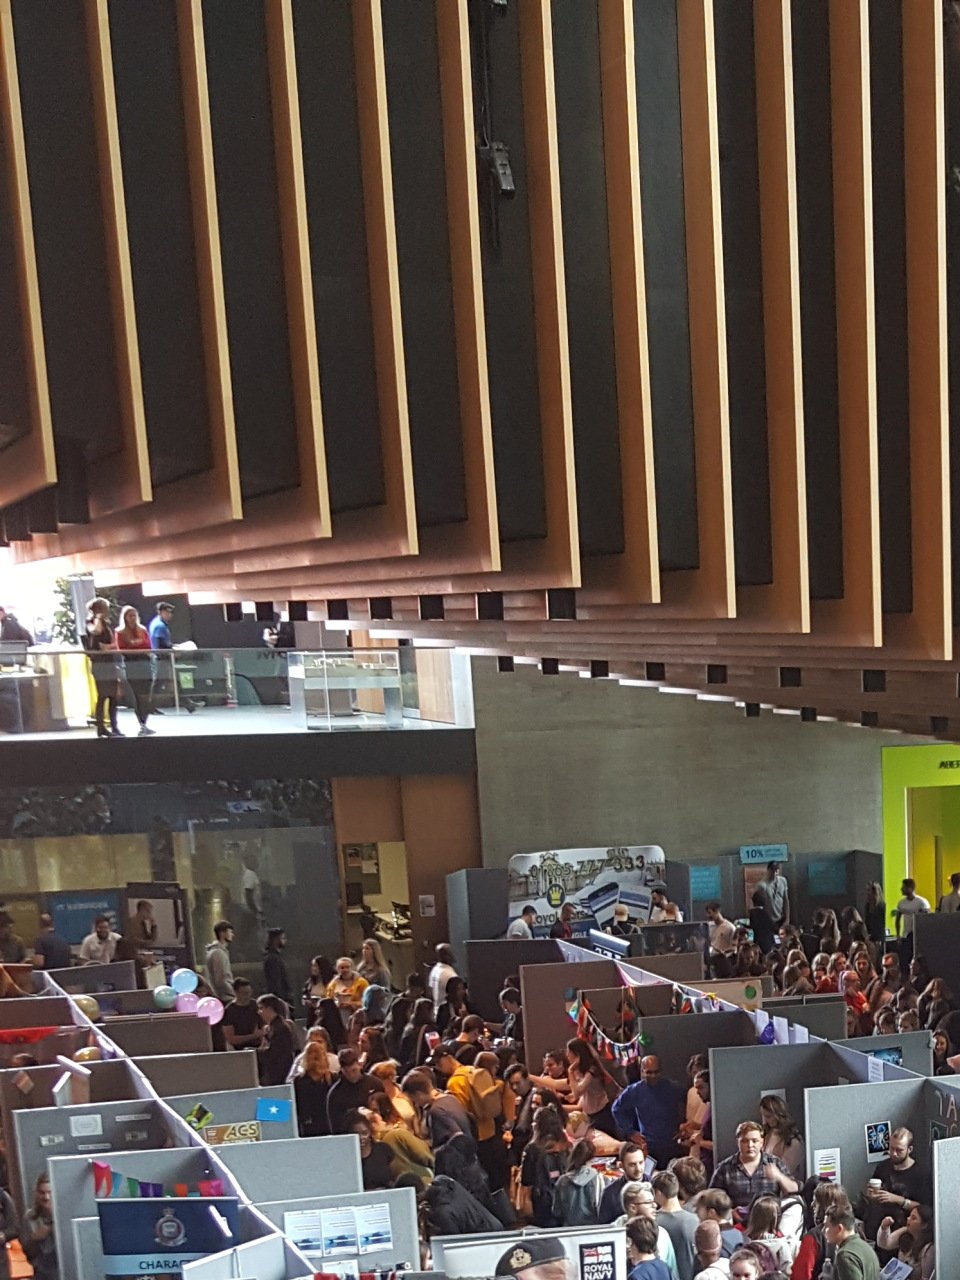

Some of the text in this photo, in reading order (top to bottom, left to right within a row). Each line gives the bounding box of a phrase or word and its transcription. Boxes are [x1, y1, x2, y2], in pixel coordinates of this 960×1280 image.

[614, 855, 646, 872] 333
[225, 1122, 257, 1139] ACS
[139, 1259, 190, 1270] CHARAC
[584, 1263, 613, 1273] ROYAL
[584, 1271, 613, 1280] NAVY
